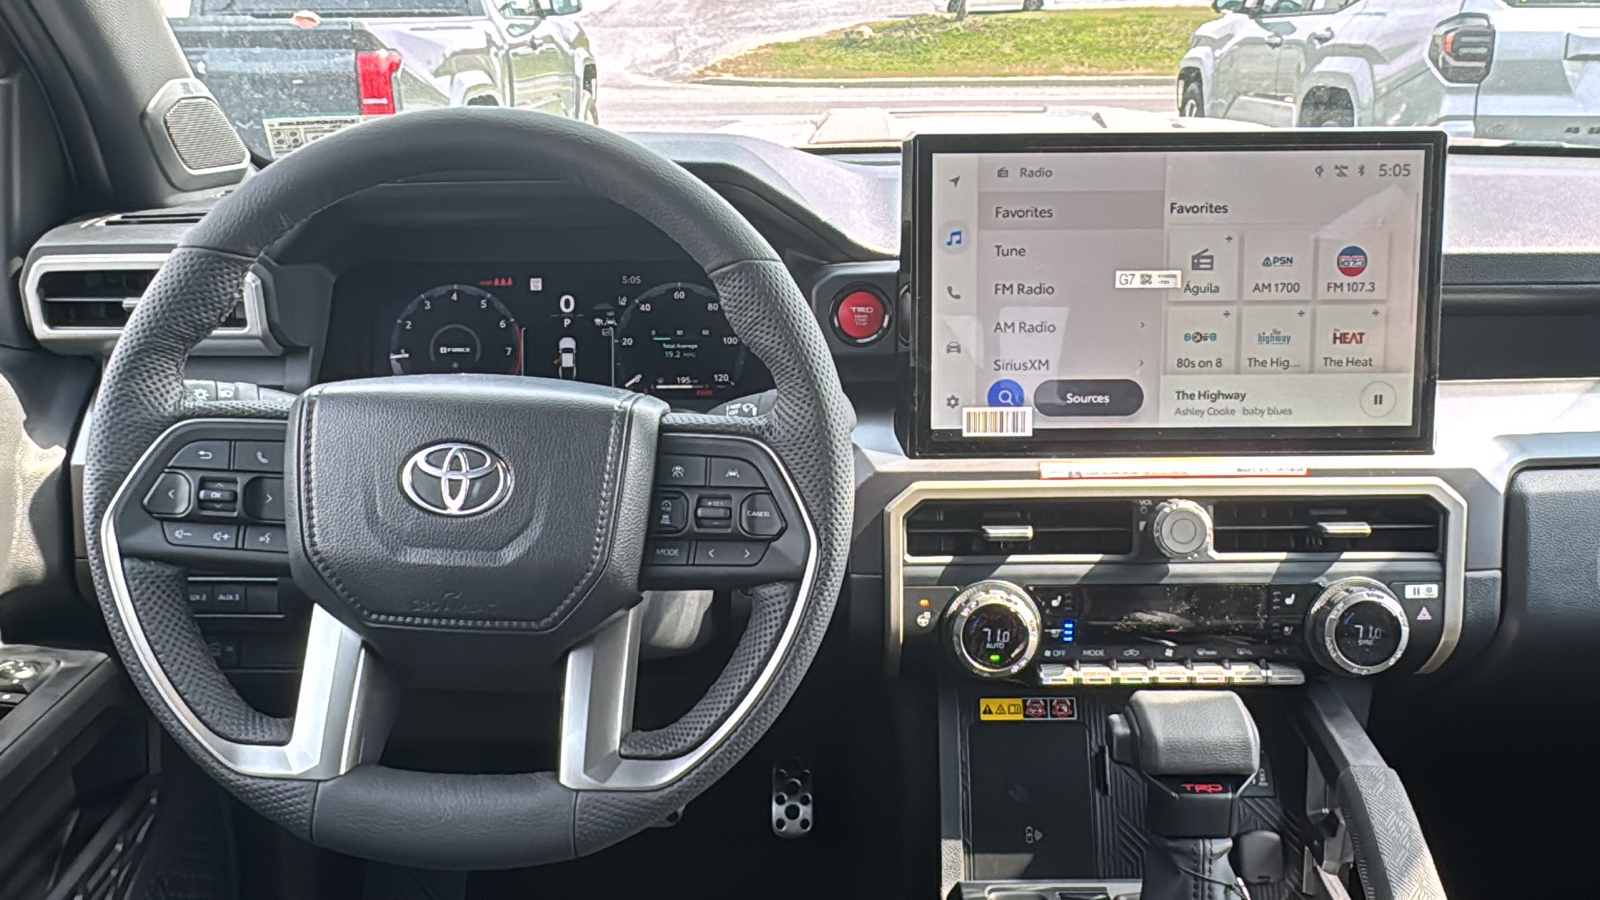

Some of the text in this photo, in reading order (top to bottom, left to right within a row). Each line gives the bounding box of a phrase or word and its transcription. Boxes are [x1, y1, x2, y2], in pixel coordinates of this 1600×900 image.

[1019, 166, 1053, 178] Radio
[1378, 163, 1412, 177] 5:05
[994, 206, 1054, 219] Favorites
[1169, 202, 1229, 215] Favorites
[994, 245, 1027, 258] Tune
[1272, 256, 1293, 266] PSN
[622, 276, 641, 284] 5:05
[1119, 273, 1136, 286] G7
[994, 282, 1055, 295] FM Radio
[1183, 280, 1220, 296] Águila
[1252, 282, 1301, 293] AM 1700
[1326, 282, 1376, 292] FM 107.3
[451, 293, 457, 301] 4
[673, 291, 685, 300] 60
[424, 301, 431, 310] 3
[480, 300, 487, 308] 5
[559, 294, 575, 313] 0
[640, 303, 651, 312] 40
[707, 303, 719, 311] 80
[405, 321, 412, 330] 2
[499, 320, 507, 329] 6
[563, 318, 571, 328] P
[993, 321, 1056, 333] AM Radio
[621, 337, 633, 346] 20
[722, 337, 739, 345] 100
[1258, 332, 1291, 344] highway
[1332, 332, 1365, 344] HEAT
[506, 347, 512, 356] 7
[664, 350, 681, 358] 19.2
[993, 359, 1050, 371] SiriusXM
[1176, 358, 1223, 369] 80s on 8
[1247, 358, 1268, 368] The
[1322, 357, 1373, 367] The Heat
[676, 376, 691, 384] 195
[713, 373, 729, 382] 120
[1066, 393, 1111, 404] Sources
[1175, 391, 1247, 403] The Highway
[1174, 407, 1293, 417] Ashley Cooke baby blues
[656, 548, 679, 556] MODE
[1181, 784, 1223, 793] TRD
